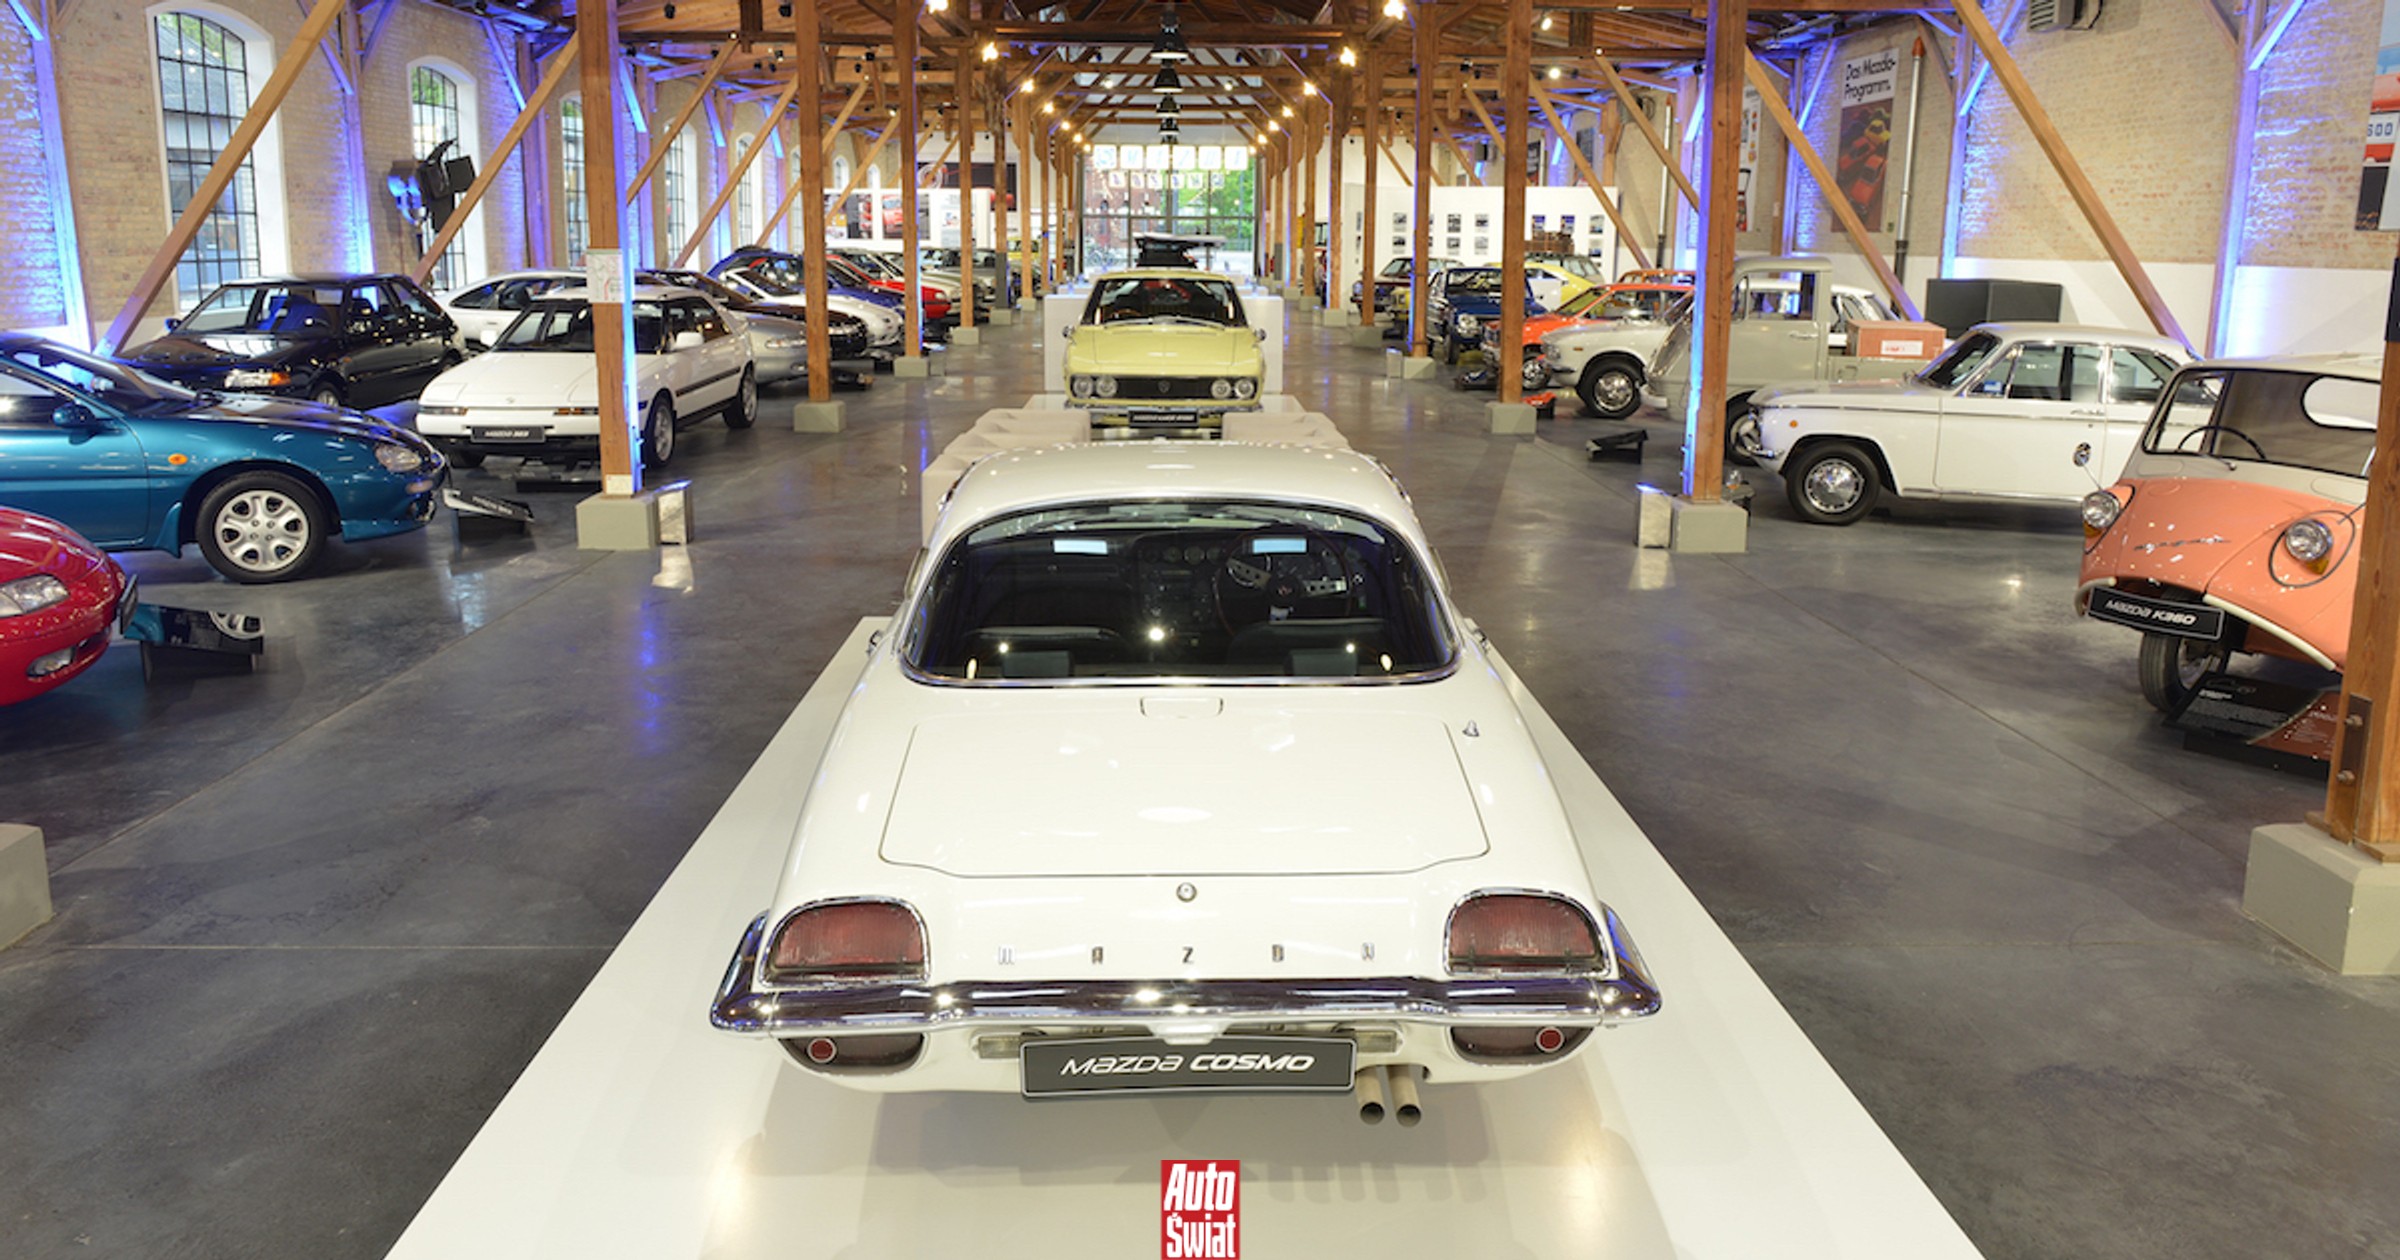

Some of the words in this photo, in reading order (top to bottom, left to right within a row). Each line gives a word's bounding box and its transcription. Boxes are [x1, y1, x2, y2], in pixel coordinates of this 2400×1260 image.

[1846, 63, 1862, 81] Das
[2152, 609, 2197, 625] K360
[1189, 1054, 1316, 1073] COSMO
